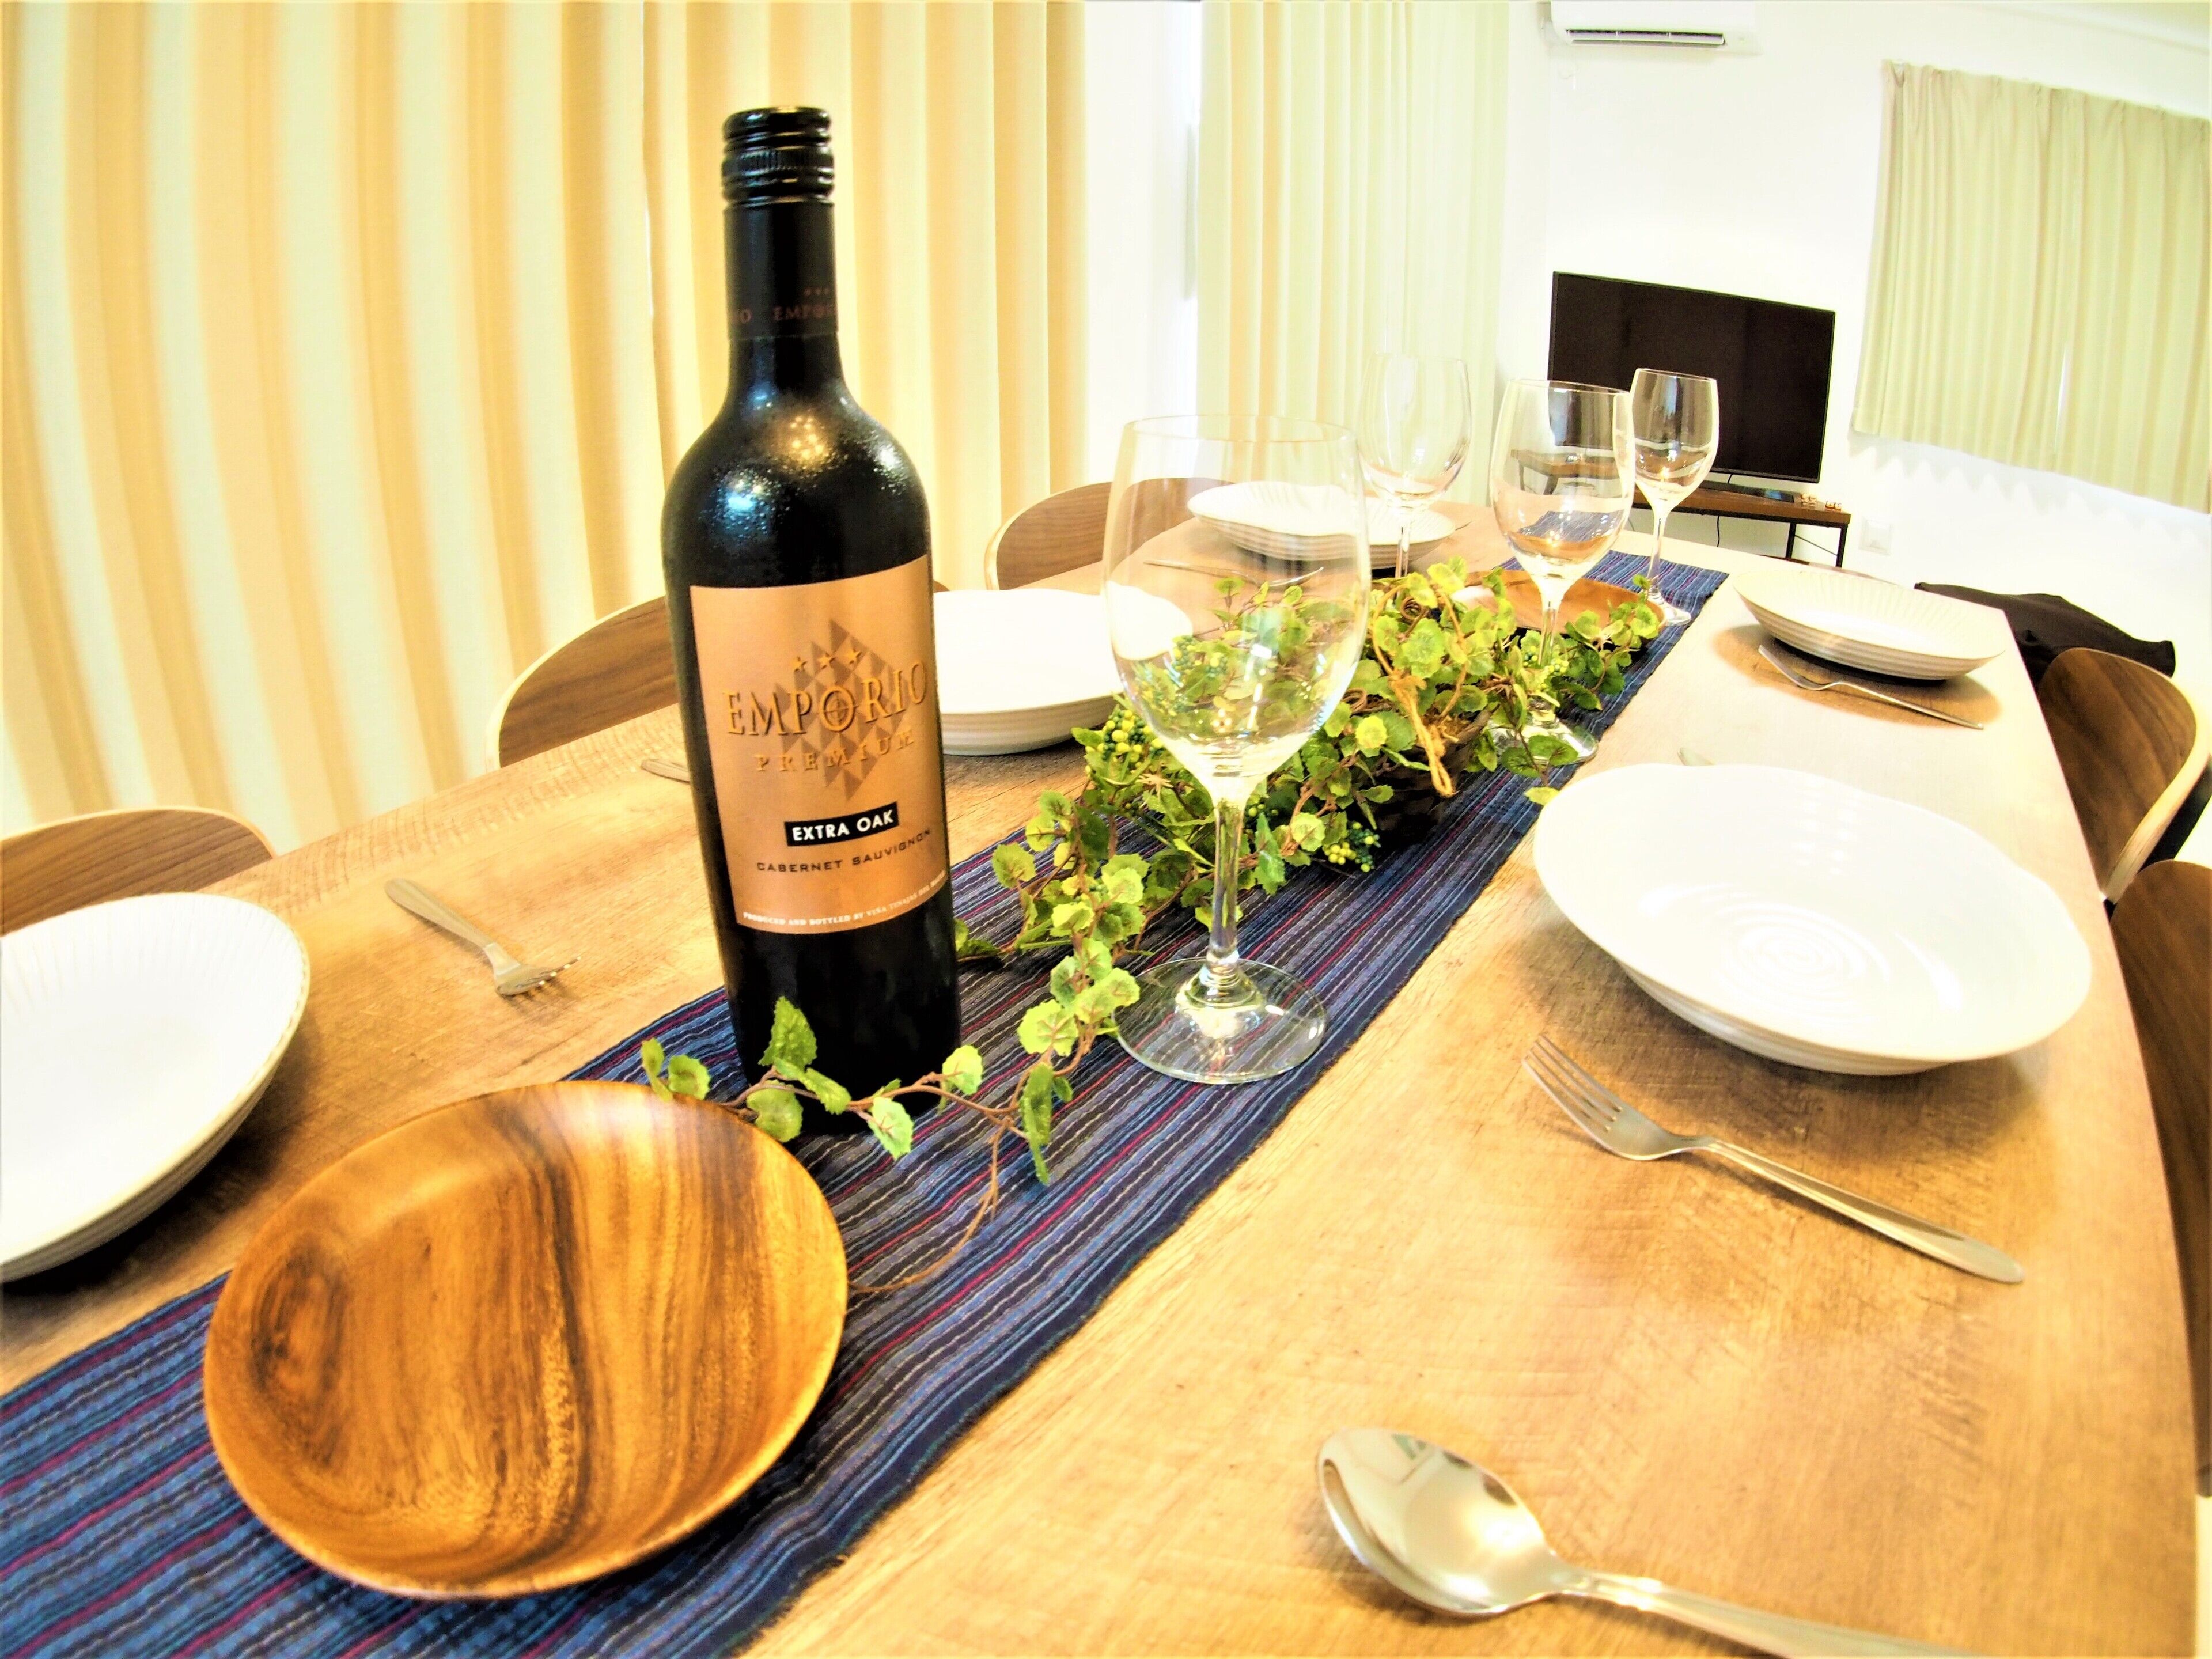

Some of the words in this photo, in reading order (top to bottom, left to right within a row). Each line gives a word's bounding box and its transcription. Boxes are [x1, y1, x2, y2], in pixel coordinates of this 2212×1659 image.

[722, 662, 927, 736] EMPORIO
[755, 729, 914, 771] PREMIUM
[791, 822, 850, 841] EXTRA
[856, 809, 894, 832] OAK
[757, 860, 843, 872] CABERNET
[852, 827, 931, 865] SAUVIGNON
[809, 915, 851, 926] BOTTLED
[853, 912, 865, 920] BY
